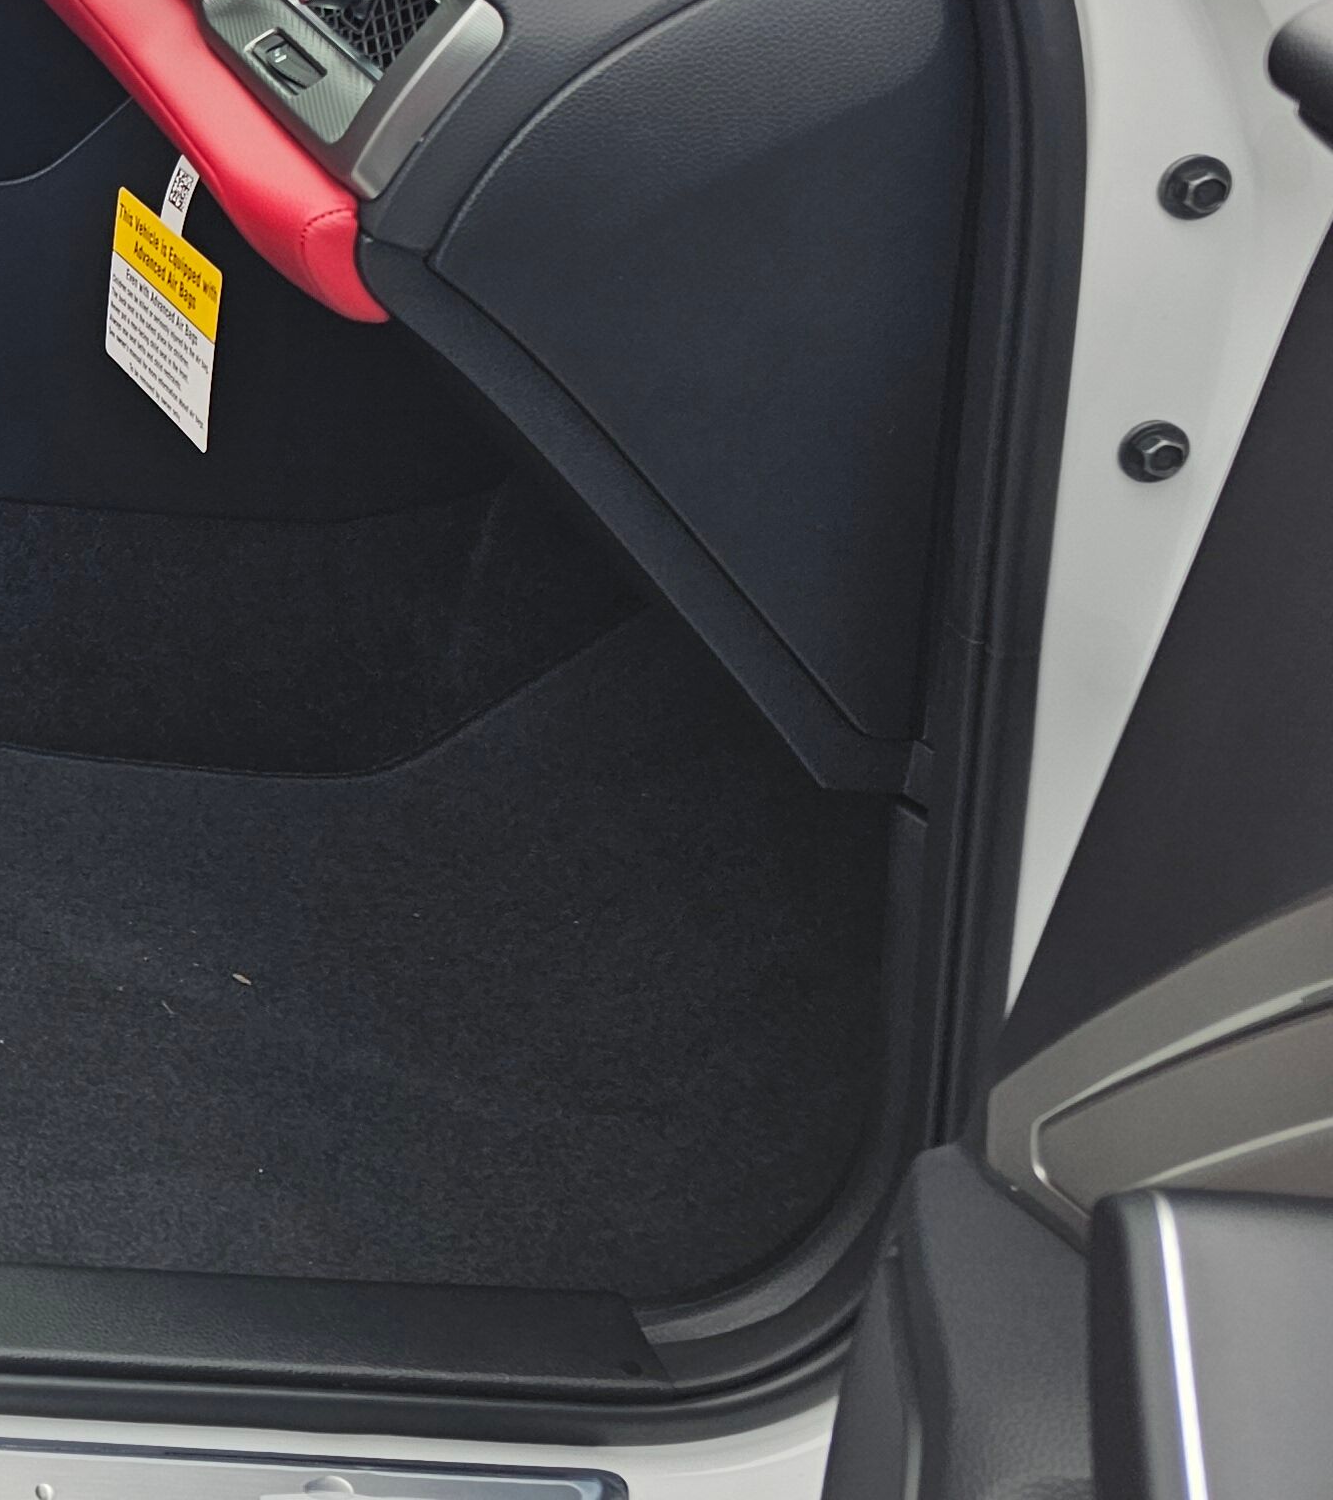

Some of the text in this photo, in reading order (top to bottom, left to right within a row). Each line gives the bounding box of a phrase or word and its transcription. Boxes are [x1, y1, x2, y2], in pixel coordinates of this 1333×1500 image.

[134, 240, 197, 310] Advanced Air Bags
[135, 217, 160, 250] Vehicle
[161, 240, 168, 258] is
[169, 247, 201, 287] Equipped
[150, 291, 176, 324] Advanced
[176, 315, 185, 332] Air
